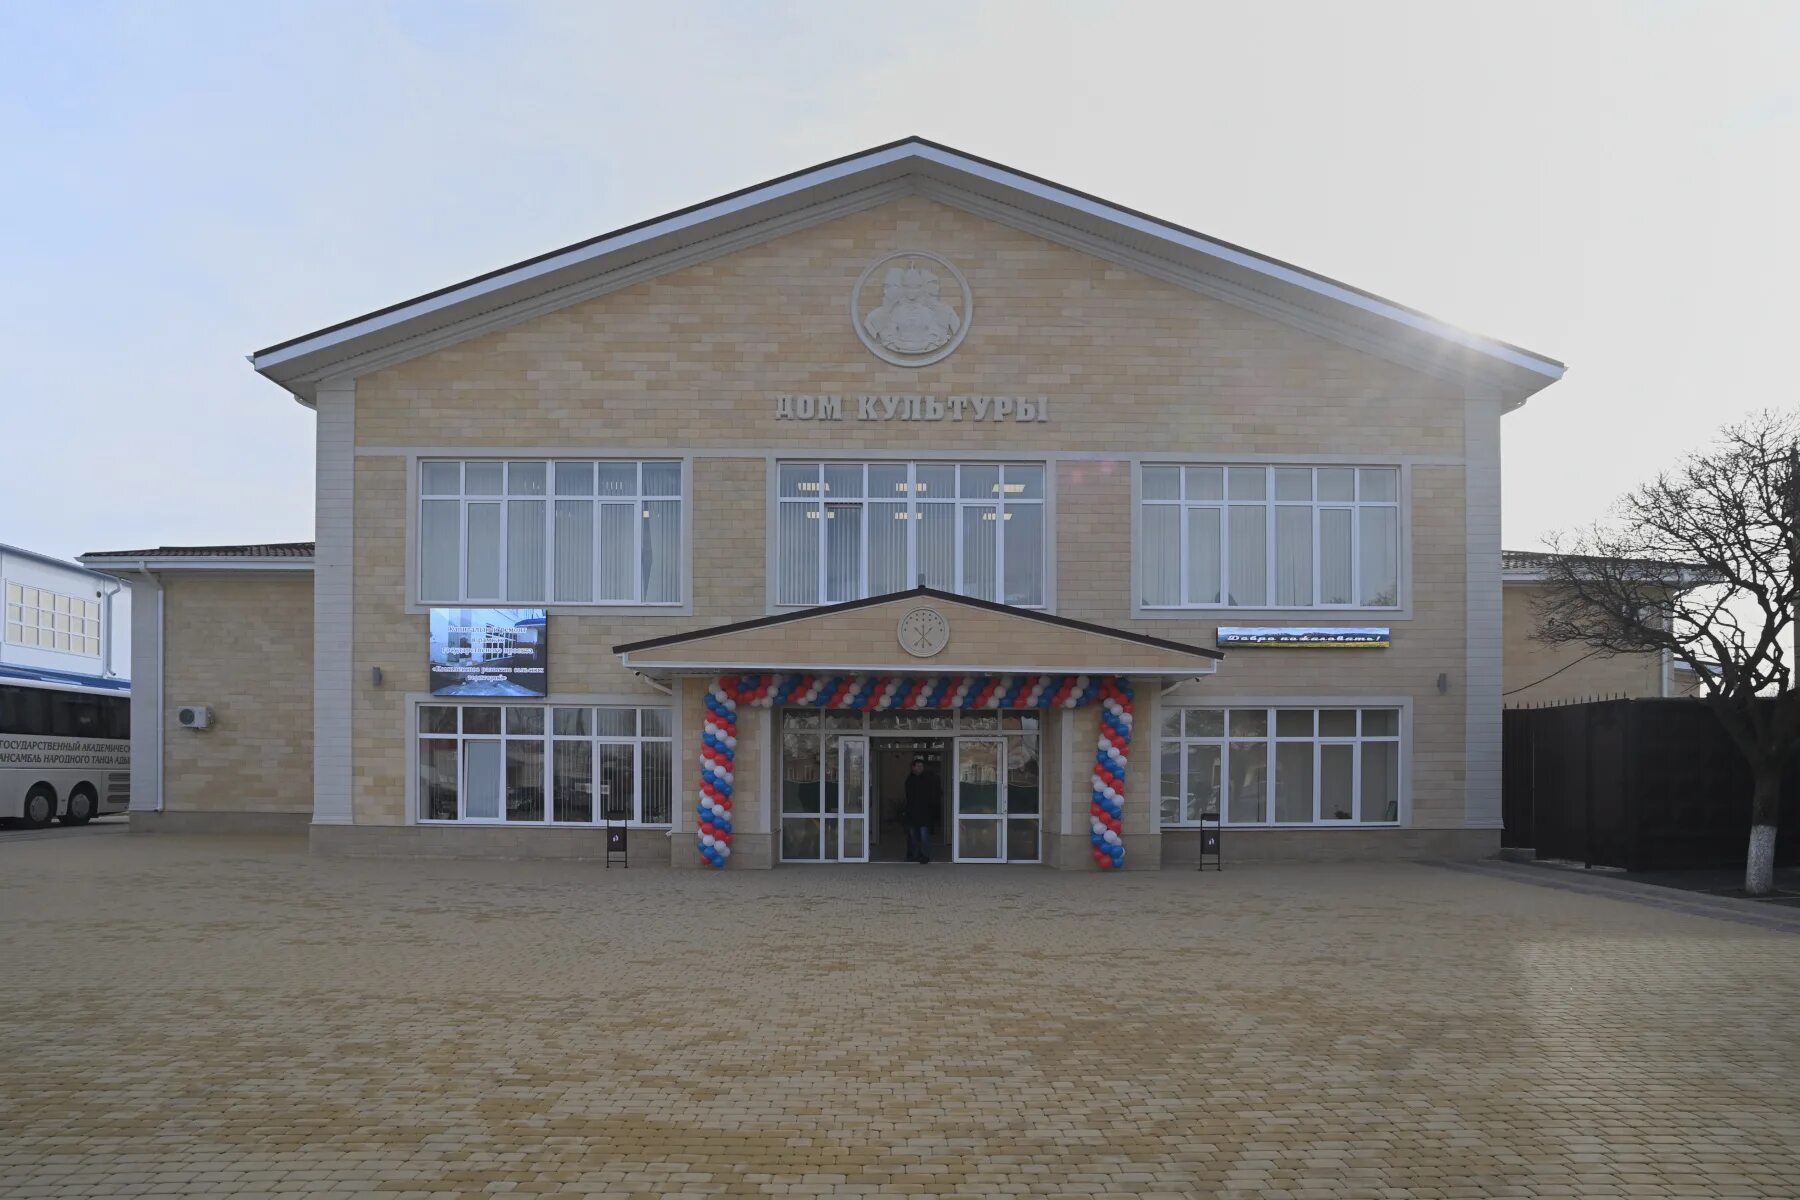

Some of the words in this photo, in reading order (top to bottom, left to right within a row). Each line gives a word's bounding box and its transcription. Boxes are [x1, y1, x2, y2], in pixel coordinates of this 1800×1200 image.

[776, 394, 843, 421] ДОМ
[856, 395, 1049, 423] КУЛЬТУРЫ
[0, 753, 42, 763] АНСАМБЛЬ
[44, 754, 90, 764] НАРОДНОГО
[92, 755, 113, 764] ТАНЦА
